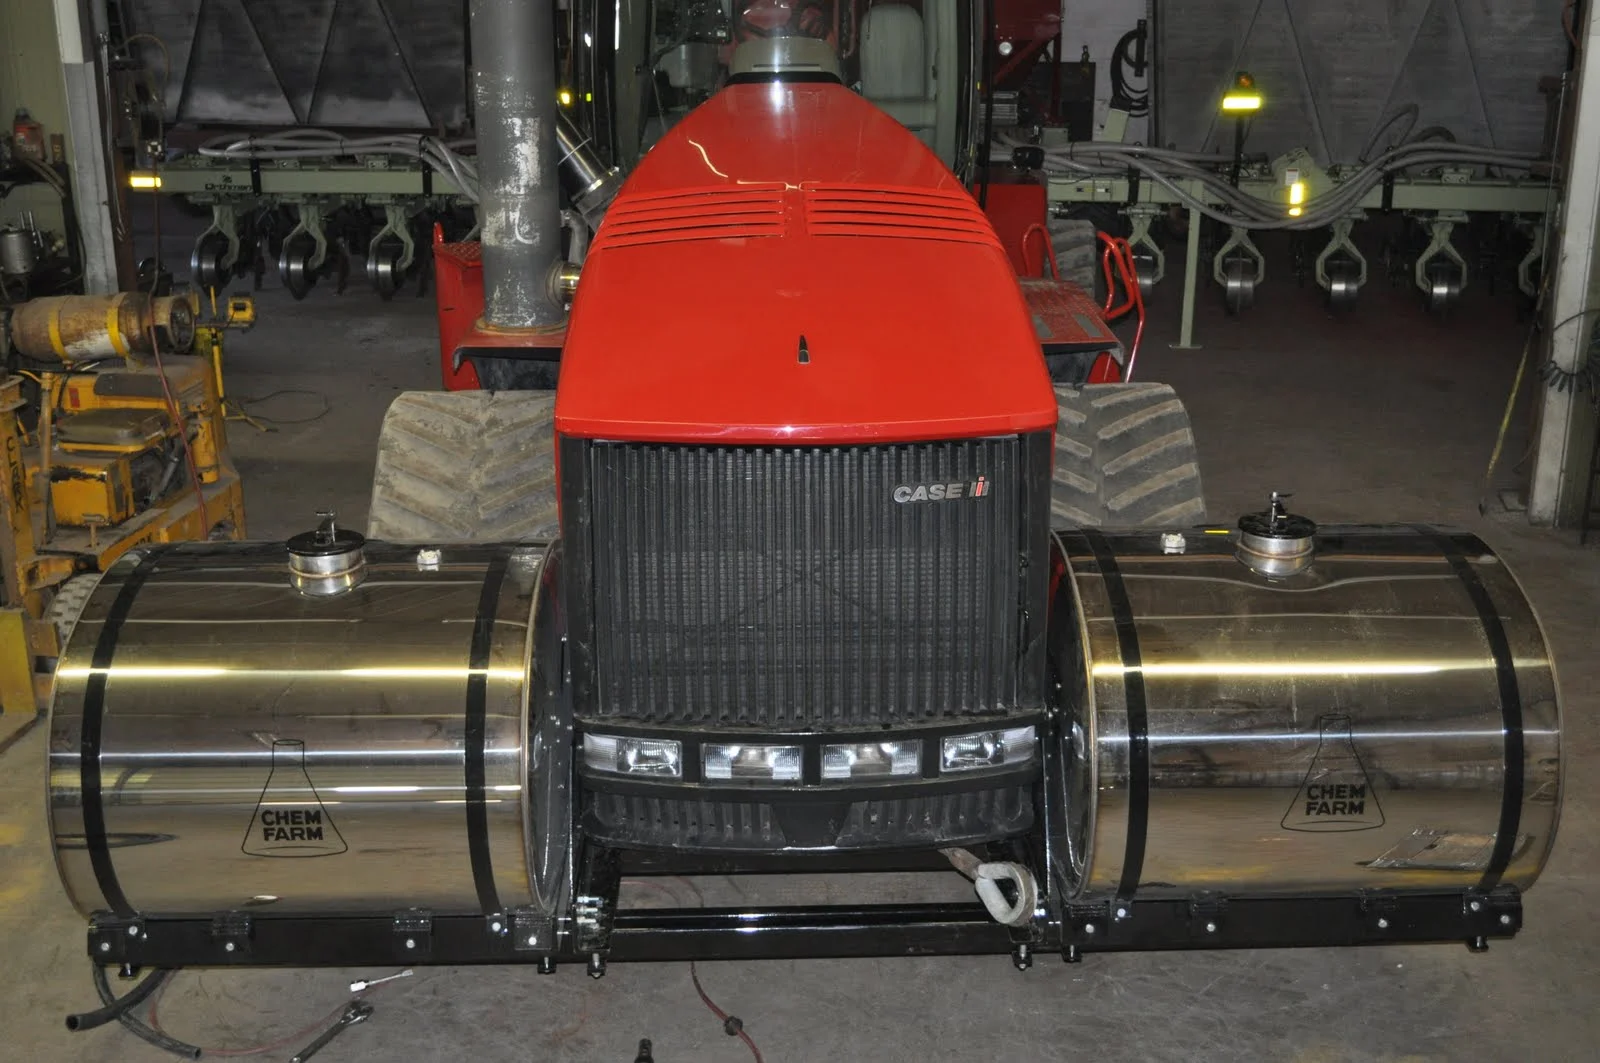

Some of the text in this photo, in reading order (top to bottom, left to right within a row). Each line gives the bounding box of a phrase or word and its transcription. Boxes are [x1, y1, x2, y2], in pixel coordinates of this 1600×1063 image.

[893, 483, 963, 503] CASE
[1307, 783, 1366, 800] CHEM
[1305, 800, 1365, 816] FARM
[261, 809, 322, 826] CHEM
[263, 826, 323, 841] FARM
